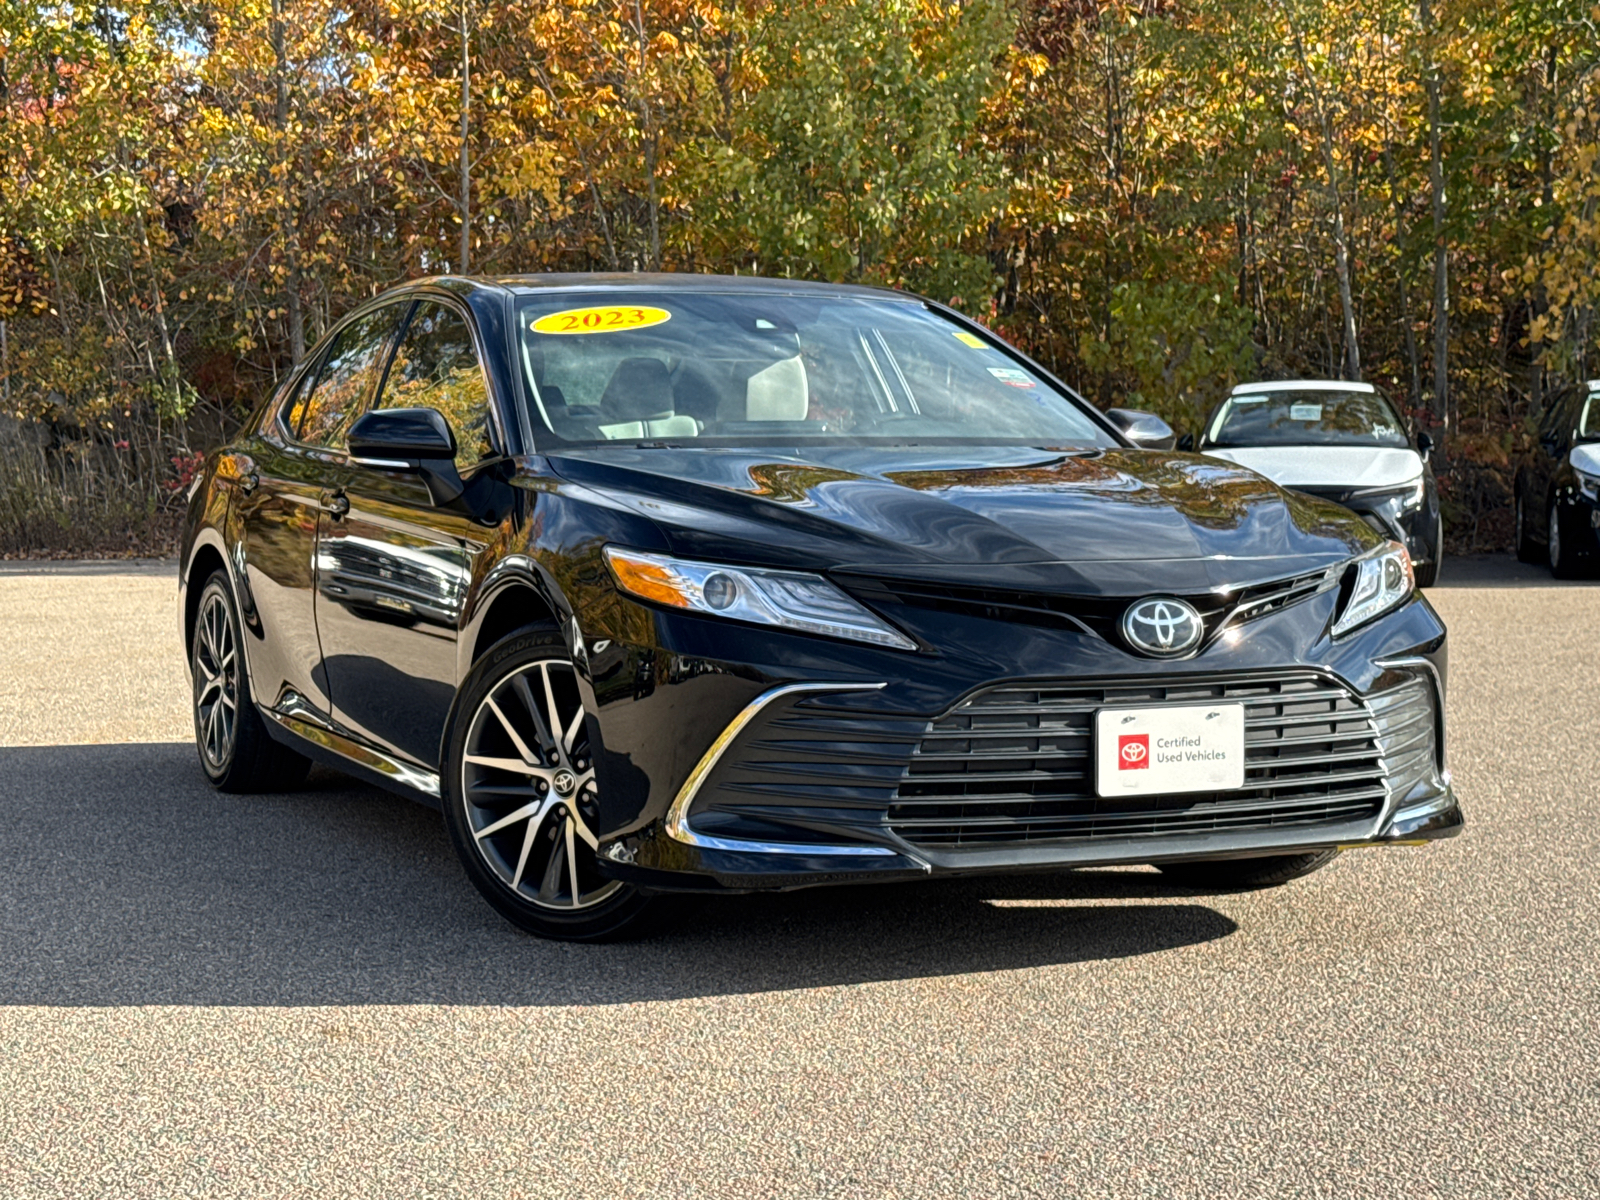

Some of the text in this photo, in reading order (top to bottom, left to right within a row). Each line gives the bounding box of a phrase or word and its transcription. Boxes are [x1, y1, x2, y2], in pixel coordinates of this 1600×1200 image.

[561, 309, 645, 331] 2023
[1157, 735, 1201, 748] Certified
[1157, 749, 1226, 763] Used Vehicles
